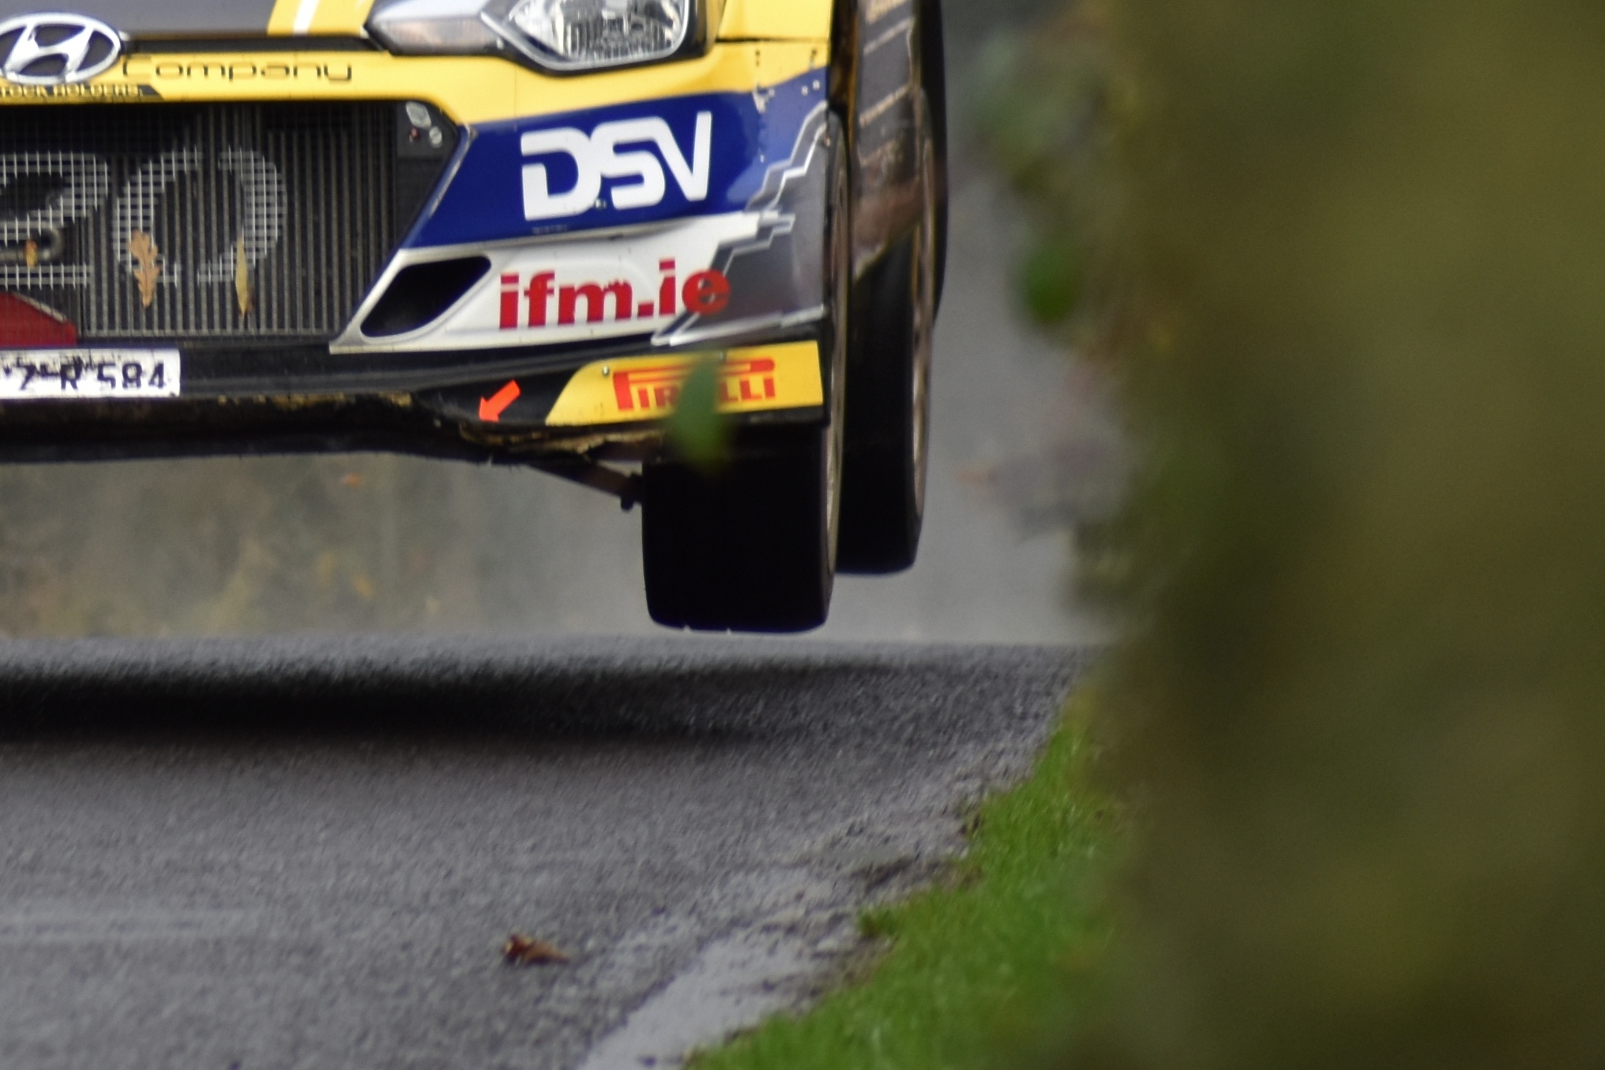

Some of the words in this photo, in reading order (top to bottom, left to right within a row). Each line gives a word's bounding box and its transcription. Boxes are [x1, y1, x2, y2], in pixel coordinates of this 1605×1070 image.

[123, 57, 353, 85] Company
[519, 110, 713, 222] DSV
[499, 258, 731, 331] ifm.ie
[613, 357, 776, 412] PIRLLI
